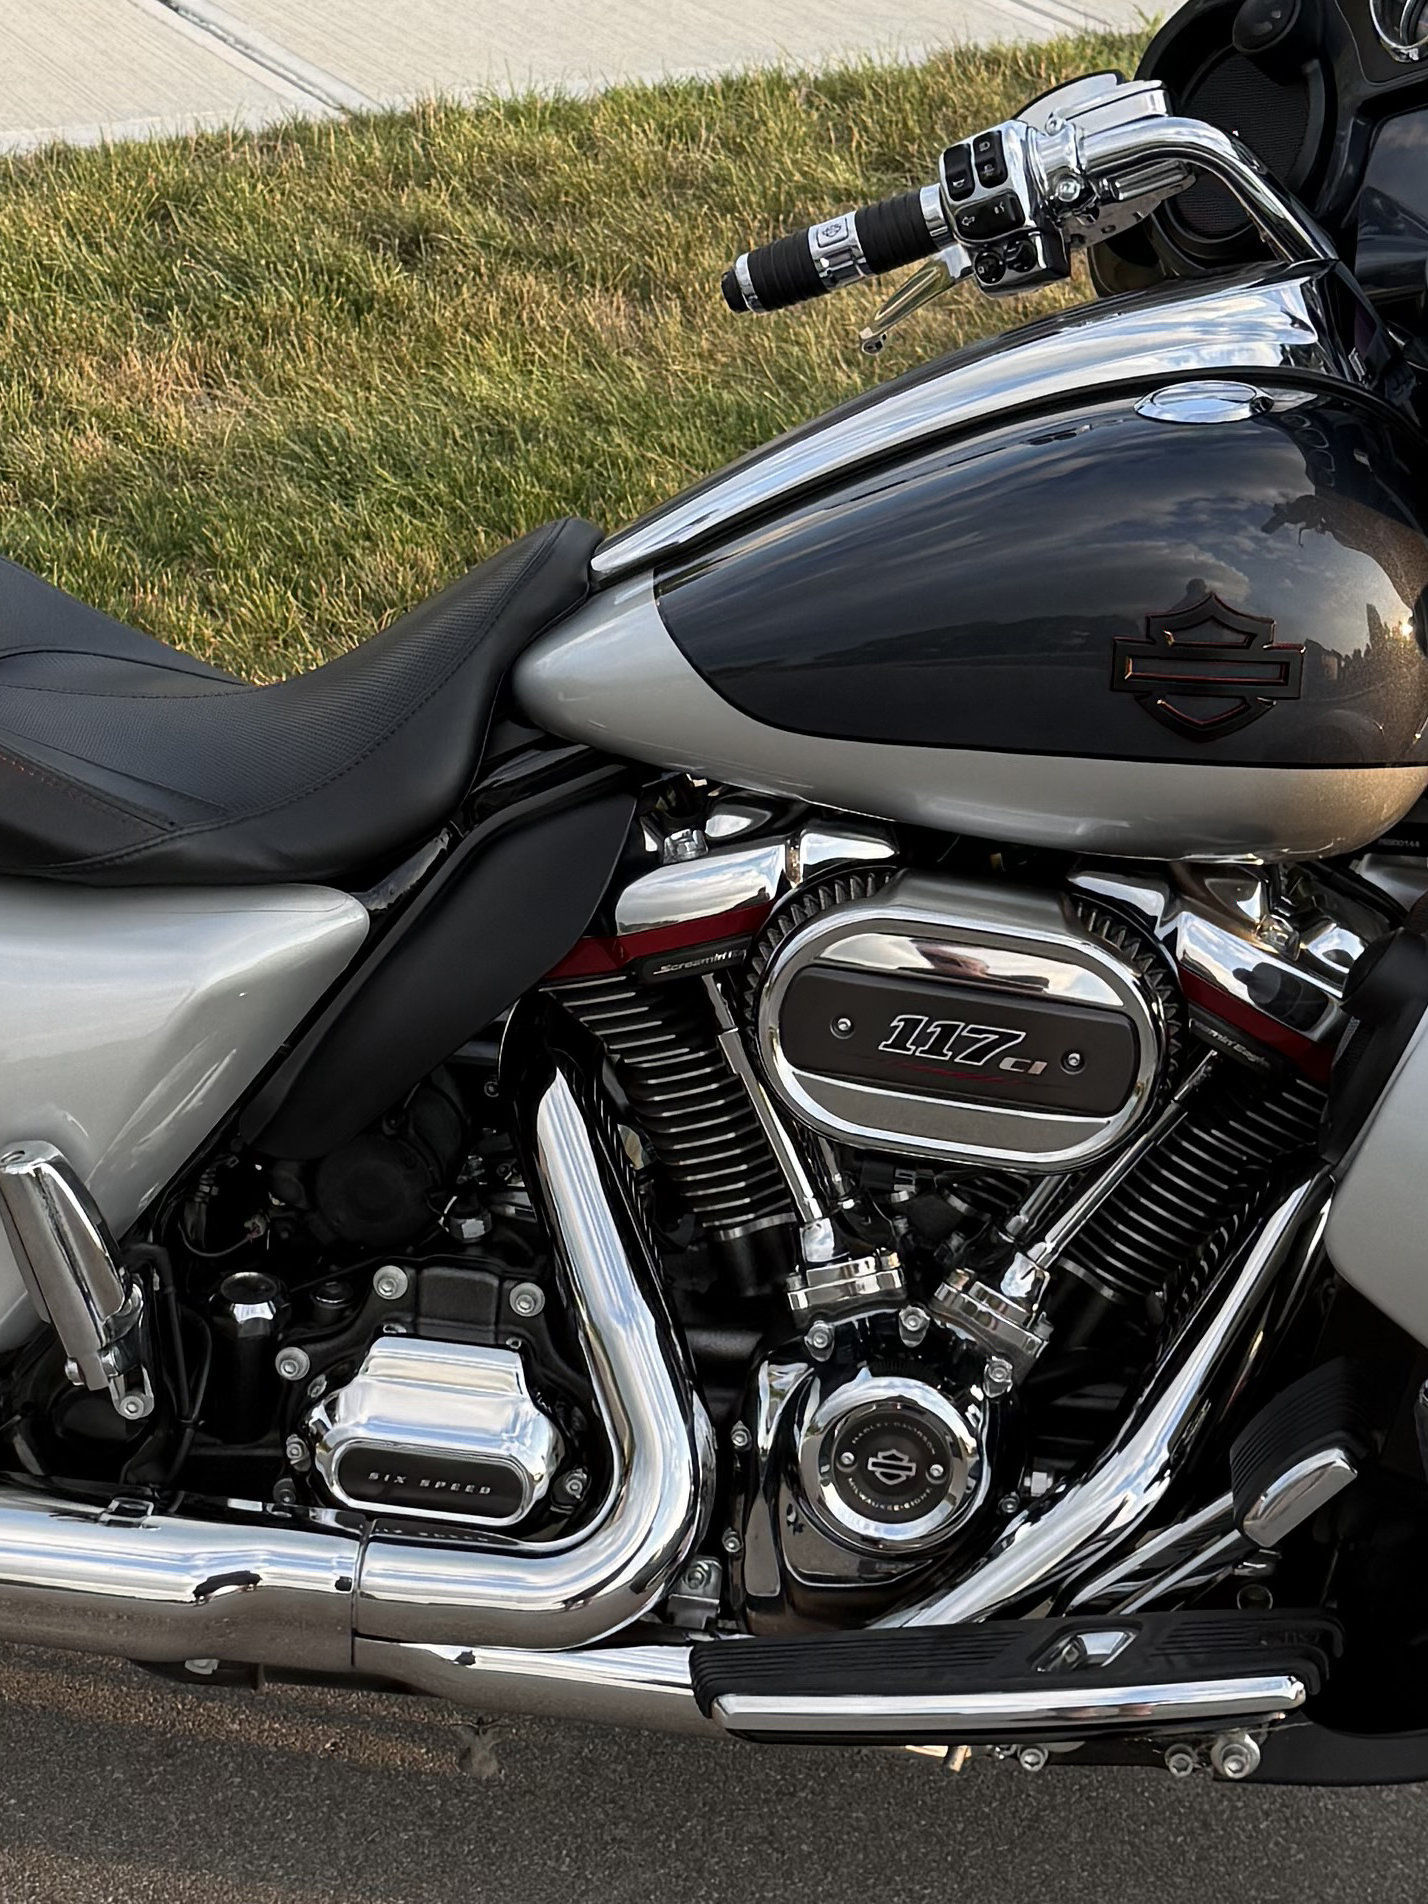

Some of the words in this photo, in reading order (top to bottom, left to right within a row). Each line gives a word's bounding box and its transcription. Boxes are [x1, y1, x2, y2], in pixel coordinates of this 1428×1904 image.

[878, 1014, 1027, 1066] 117
[999, 1057, 1048, 1076] CI
[368, 1471, 407, 1485] SIX
[419, 1479, 492, 1496] SPEED
